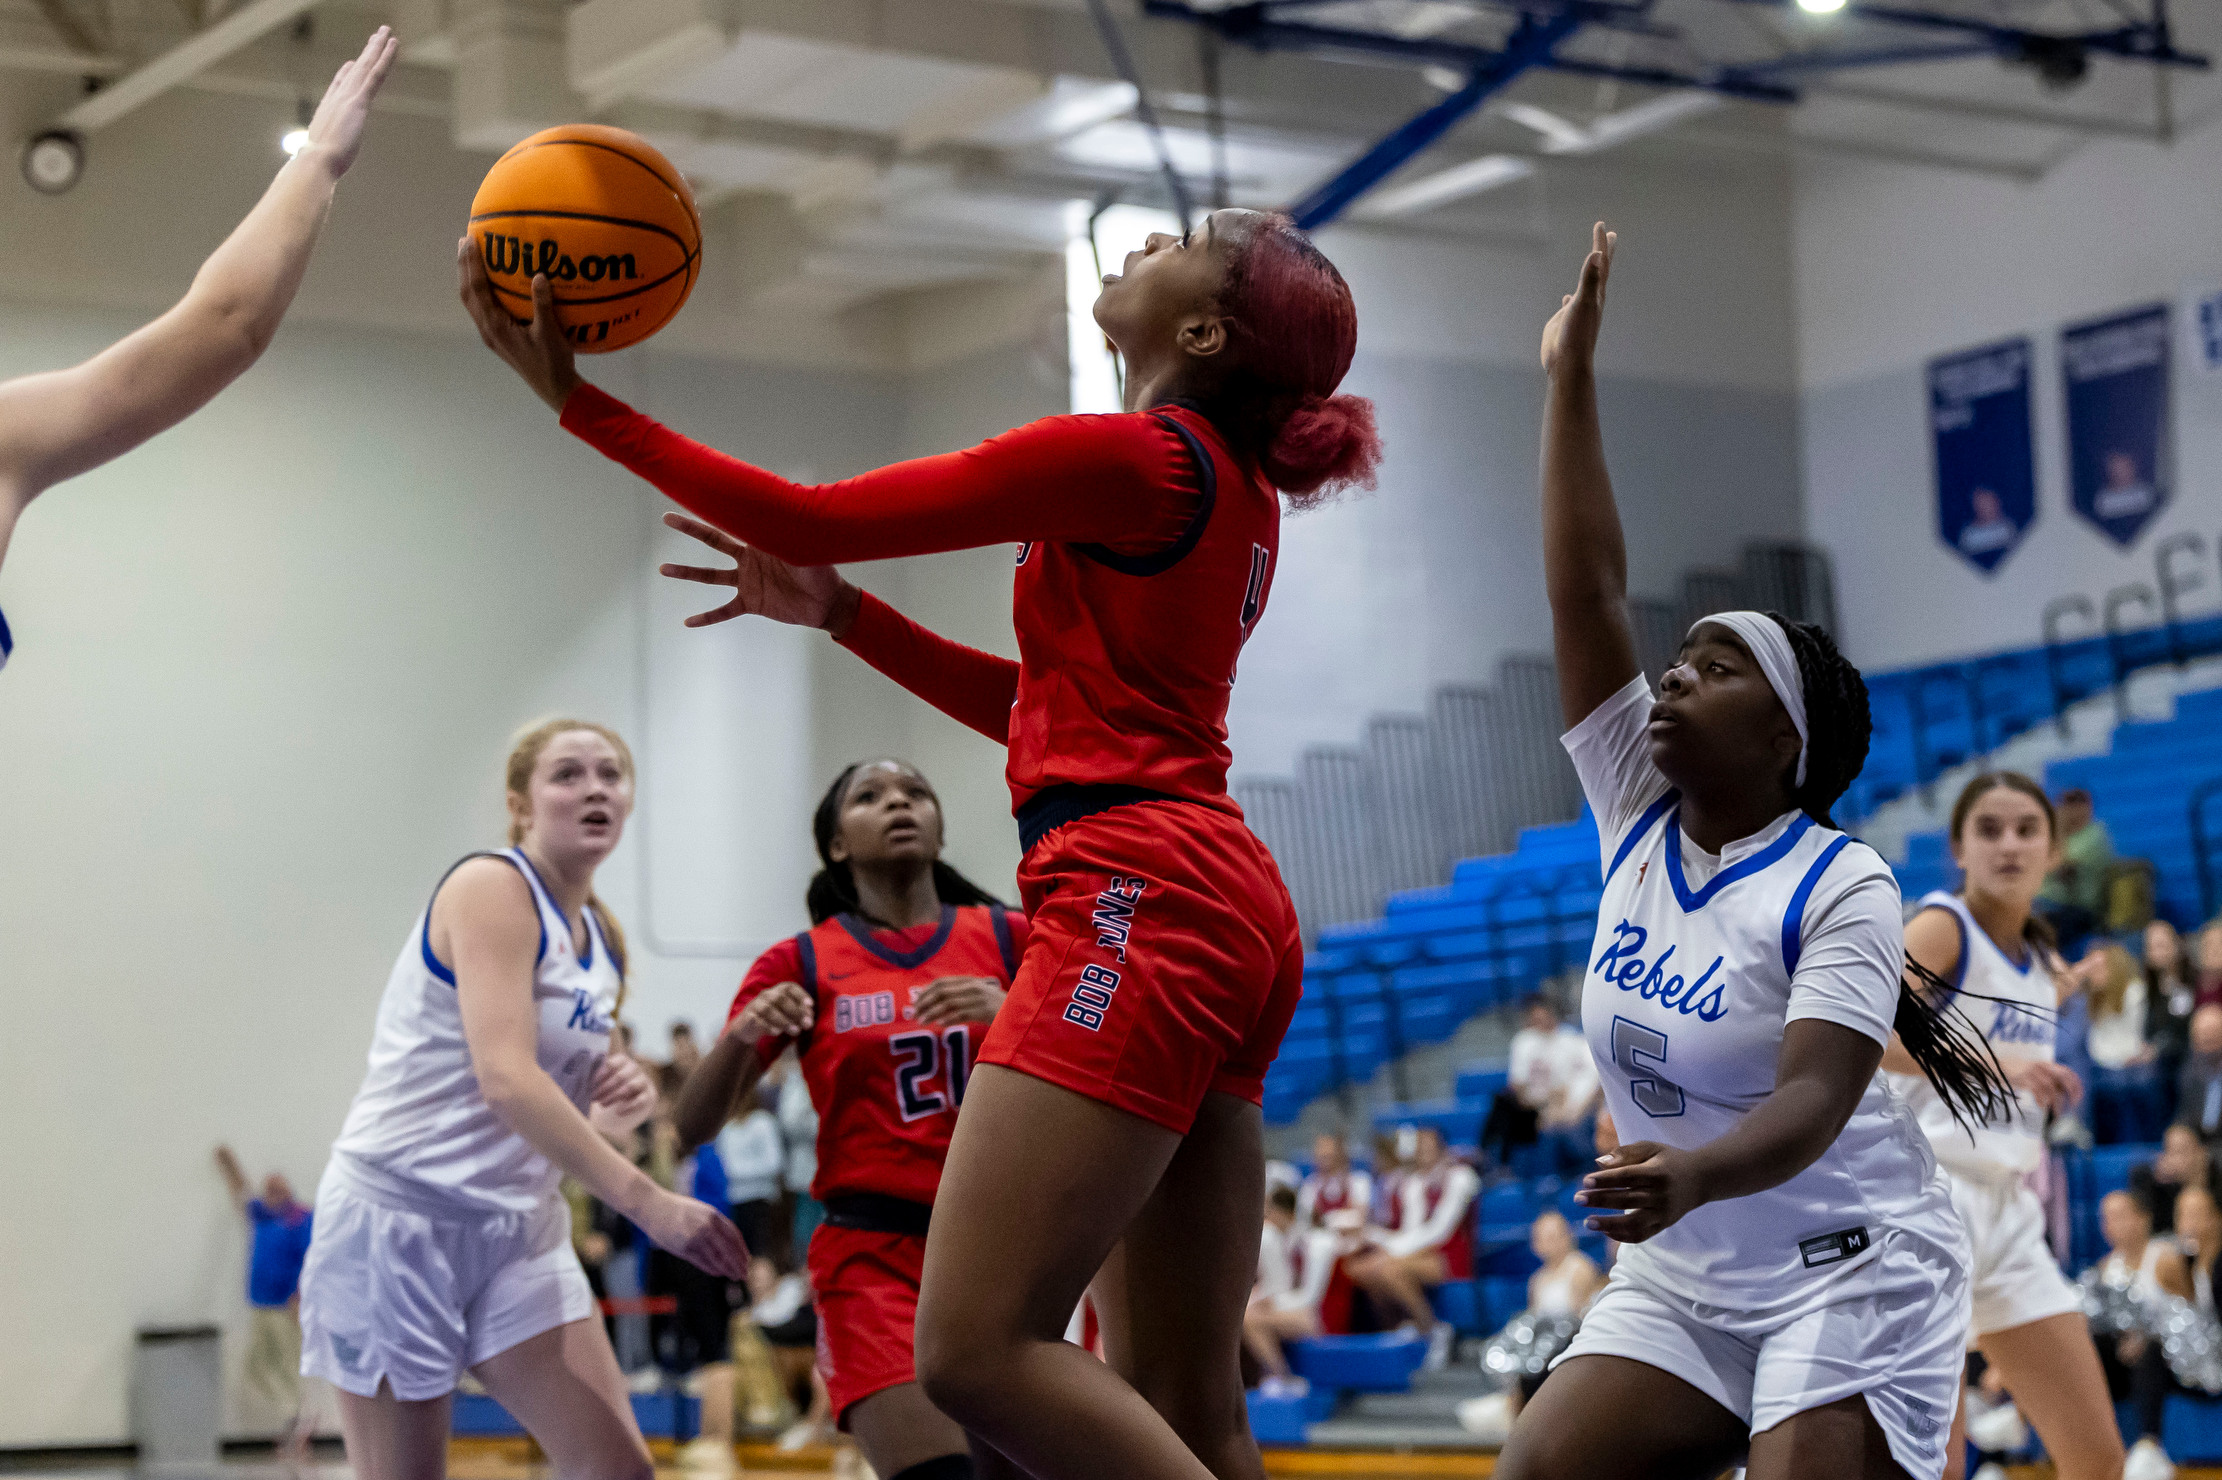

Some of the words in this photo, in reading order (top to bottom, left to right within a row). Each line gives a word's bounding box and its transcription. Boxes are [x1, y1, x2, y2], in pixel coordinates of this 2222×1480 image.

[484, 231, 640, 283] Wilson
[1062, 963, 1121, 1032] BOB
[1594, 918, 1728, 1022] Rebels
[835, 990, 895, 1034] BOB
[889, 1025, 970, 1123] 21
[1610, 1014, 1686, 1118] 5
[1847, 1234, 1862, 1249] M
